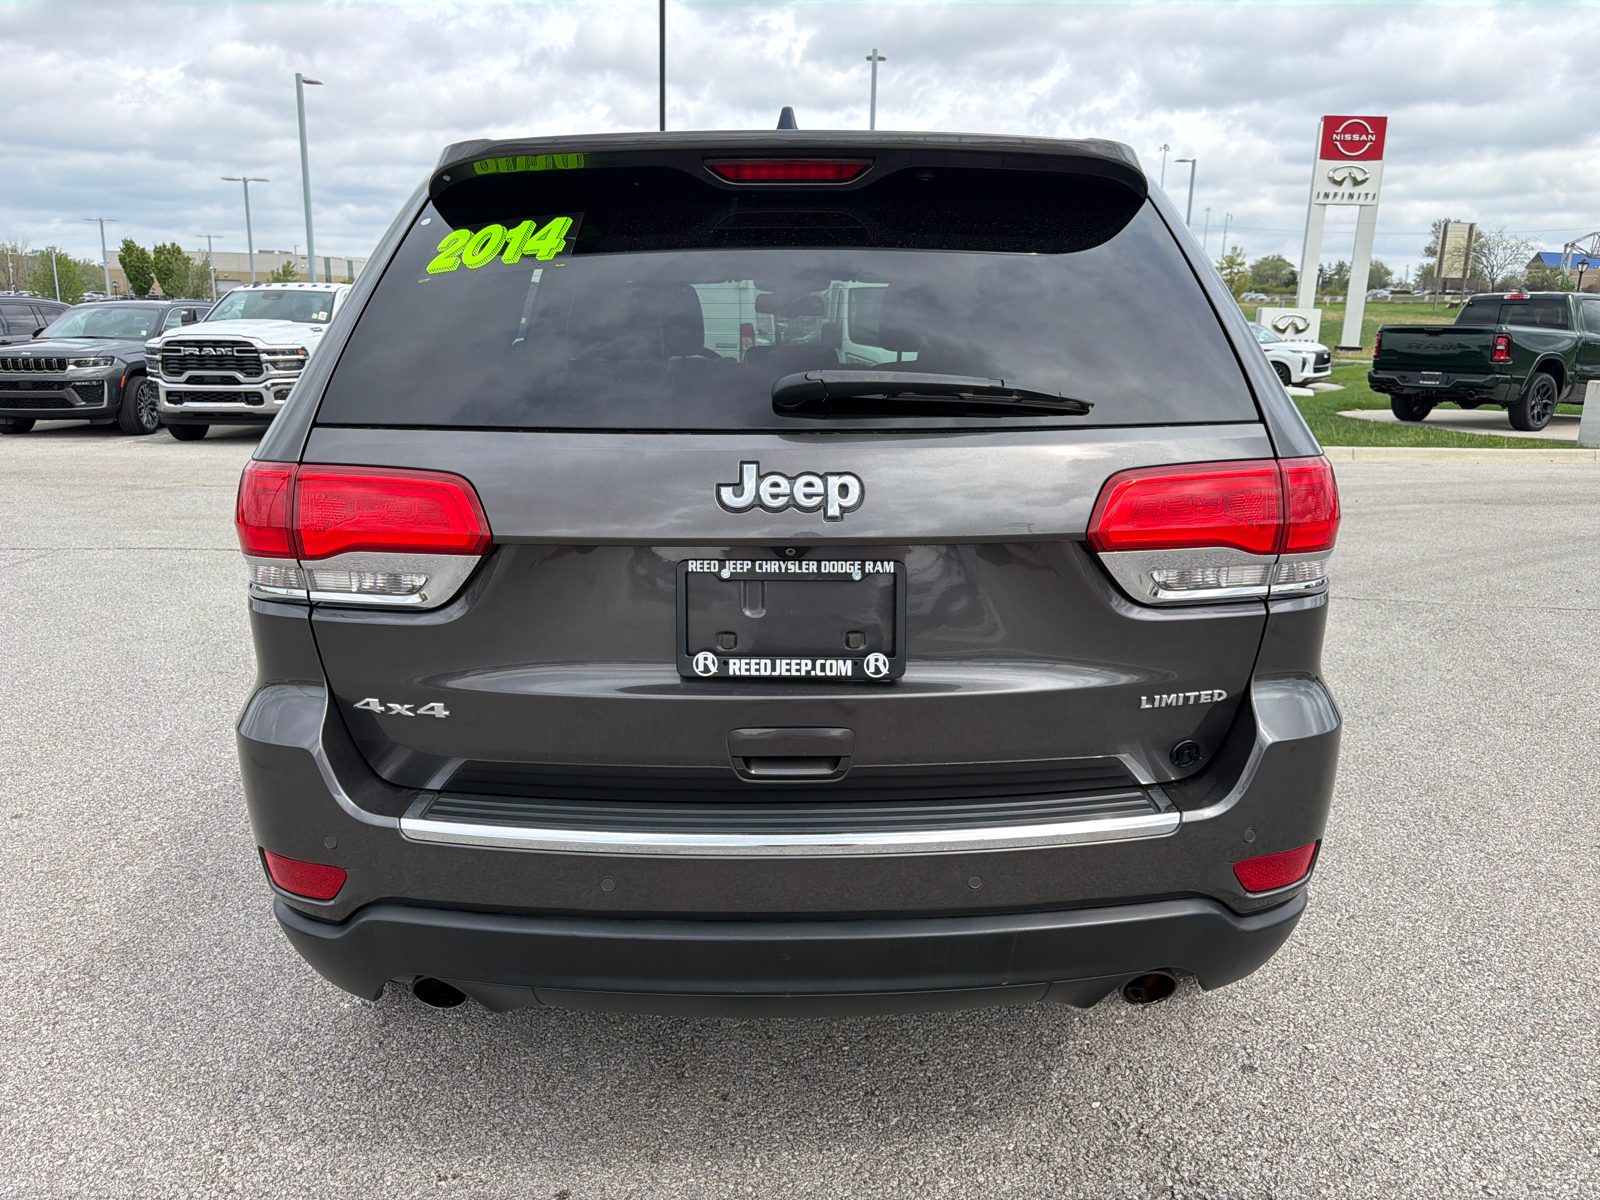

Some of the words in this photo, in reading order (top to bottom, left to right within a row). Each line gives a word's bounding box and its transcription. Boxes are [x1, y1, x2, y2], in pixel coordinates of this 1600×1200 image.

[1316, 191, 1376, 200] INFINITI
[426, 216, 573, 274] 2014
[183, 347, 233, 356] RAM
[717, 462, 862, 520] Jeep
[688, 560, 719, 573] REED
[725, 560, 752, 573] JEEP
[755, 560, 818, 573] CHRYSLER
[820, 561, 861, 574] DODGE
[865, 561, 894, 573] RAM
[729, 659, 853, 676] REEDJEEP.COM
[353, 698, 450, 718] 4x4
[1140, 689, 1227, 709] LIMITED
